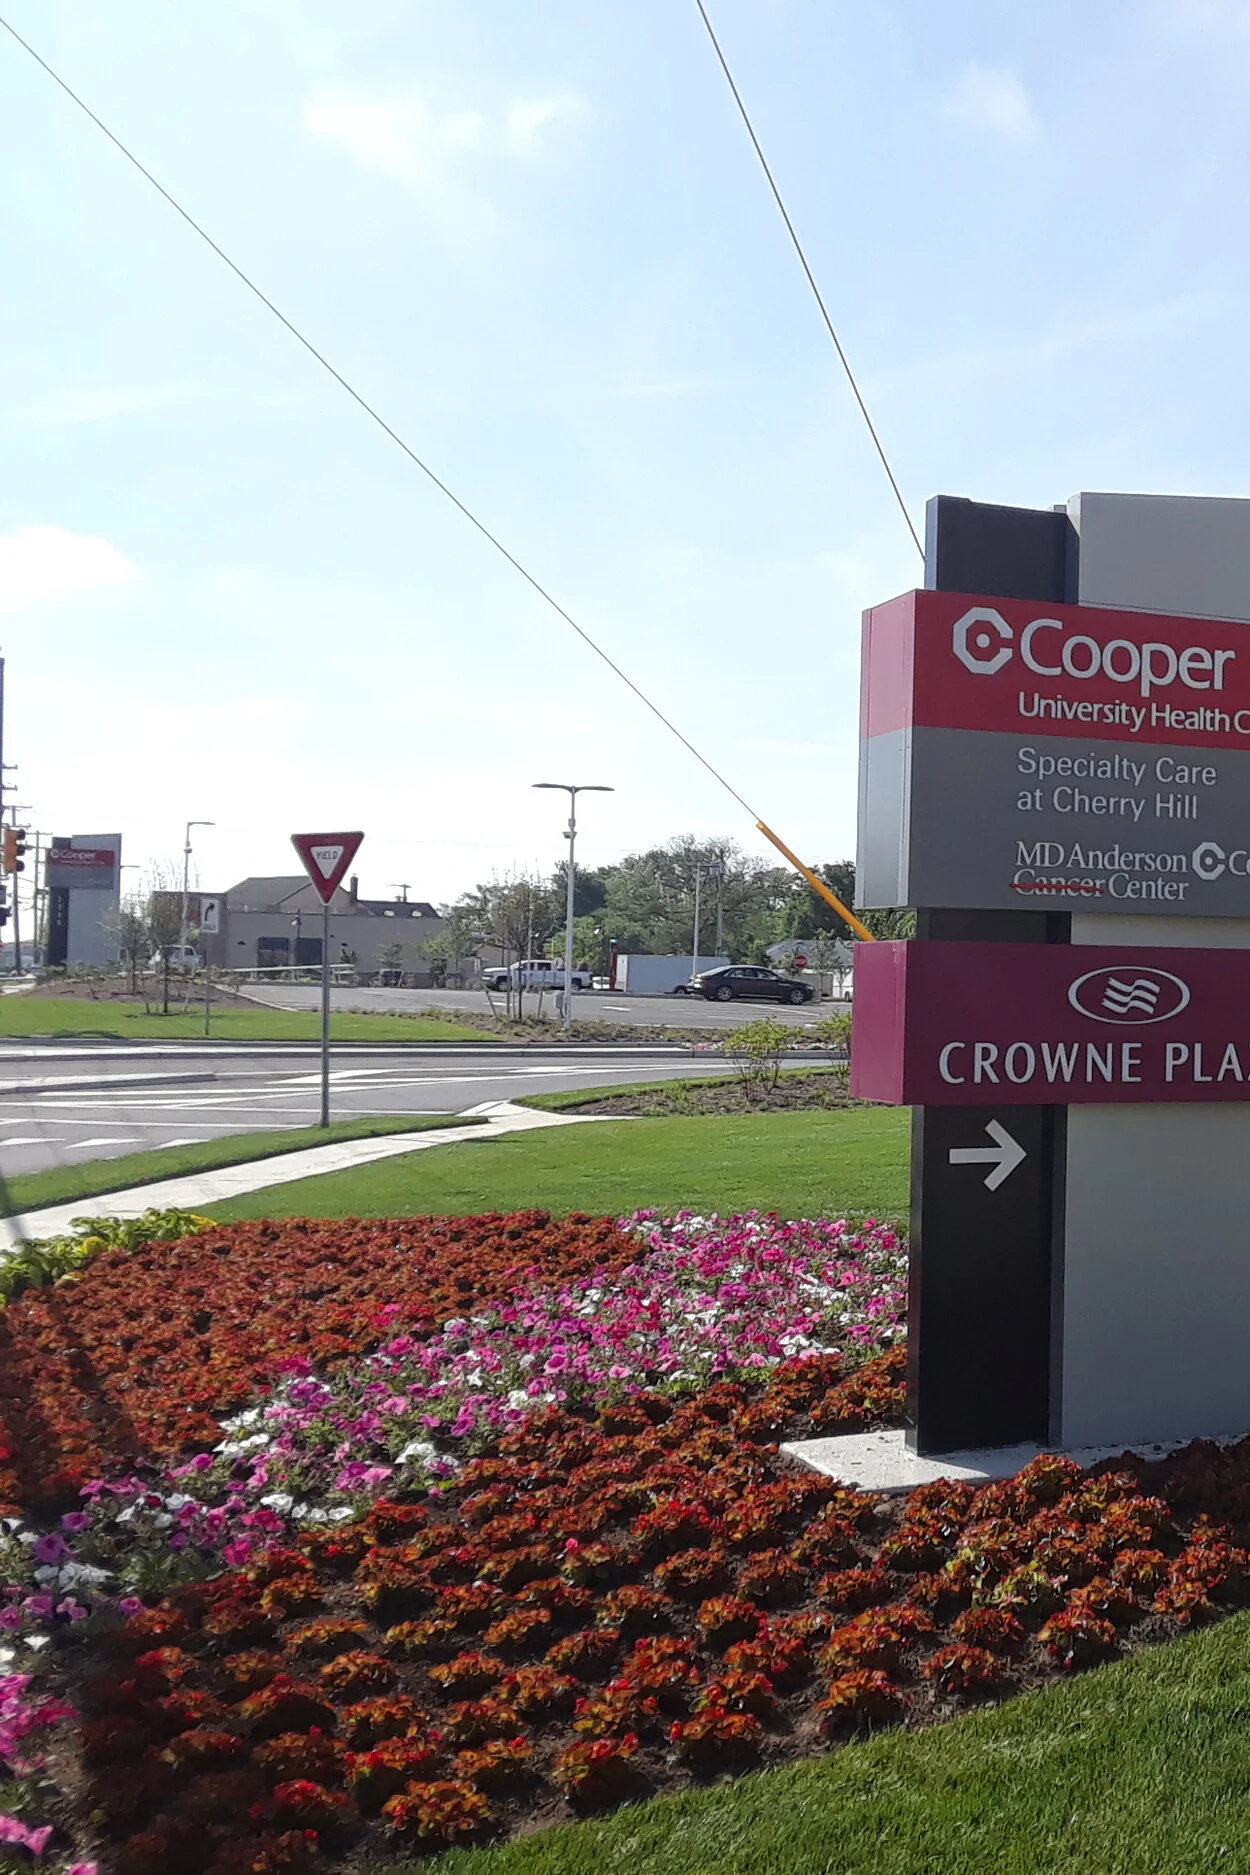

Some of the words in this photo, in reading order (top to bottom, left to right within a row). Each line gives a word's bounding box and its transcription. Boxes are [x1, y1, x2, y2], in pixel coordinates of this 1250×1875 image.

[1020, 618, 1236, 698] Cooper
[1019, 690, 1147, 733] University
[1017, 747, 1147, 787] Specialty
[1155, 756, 1217, 785] Care
[1016, 788, 1043, 811] at
[1052, 786, 1146, 822] Cherry
[1155, 792, 1198, 819] Hill
[316, 850, 339, 861] YIELD
[1015, 840, 1065, 868] MD
[1065, 842, 1189, 873] Anderson
[1012, 868, 1105, 898] Cancer
[1108, 872, 1190, 900] Center
[938, 1041, 1142, 1085] CROWNE
